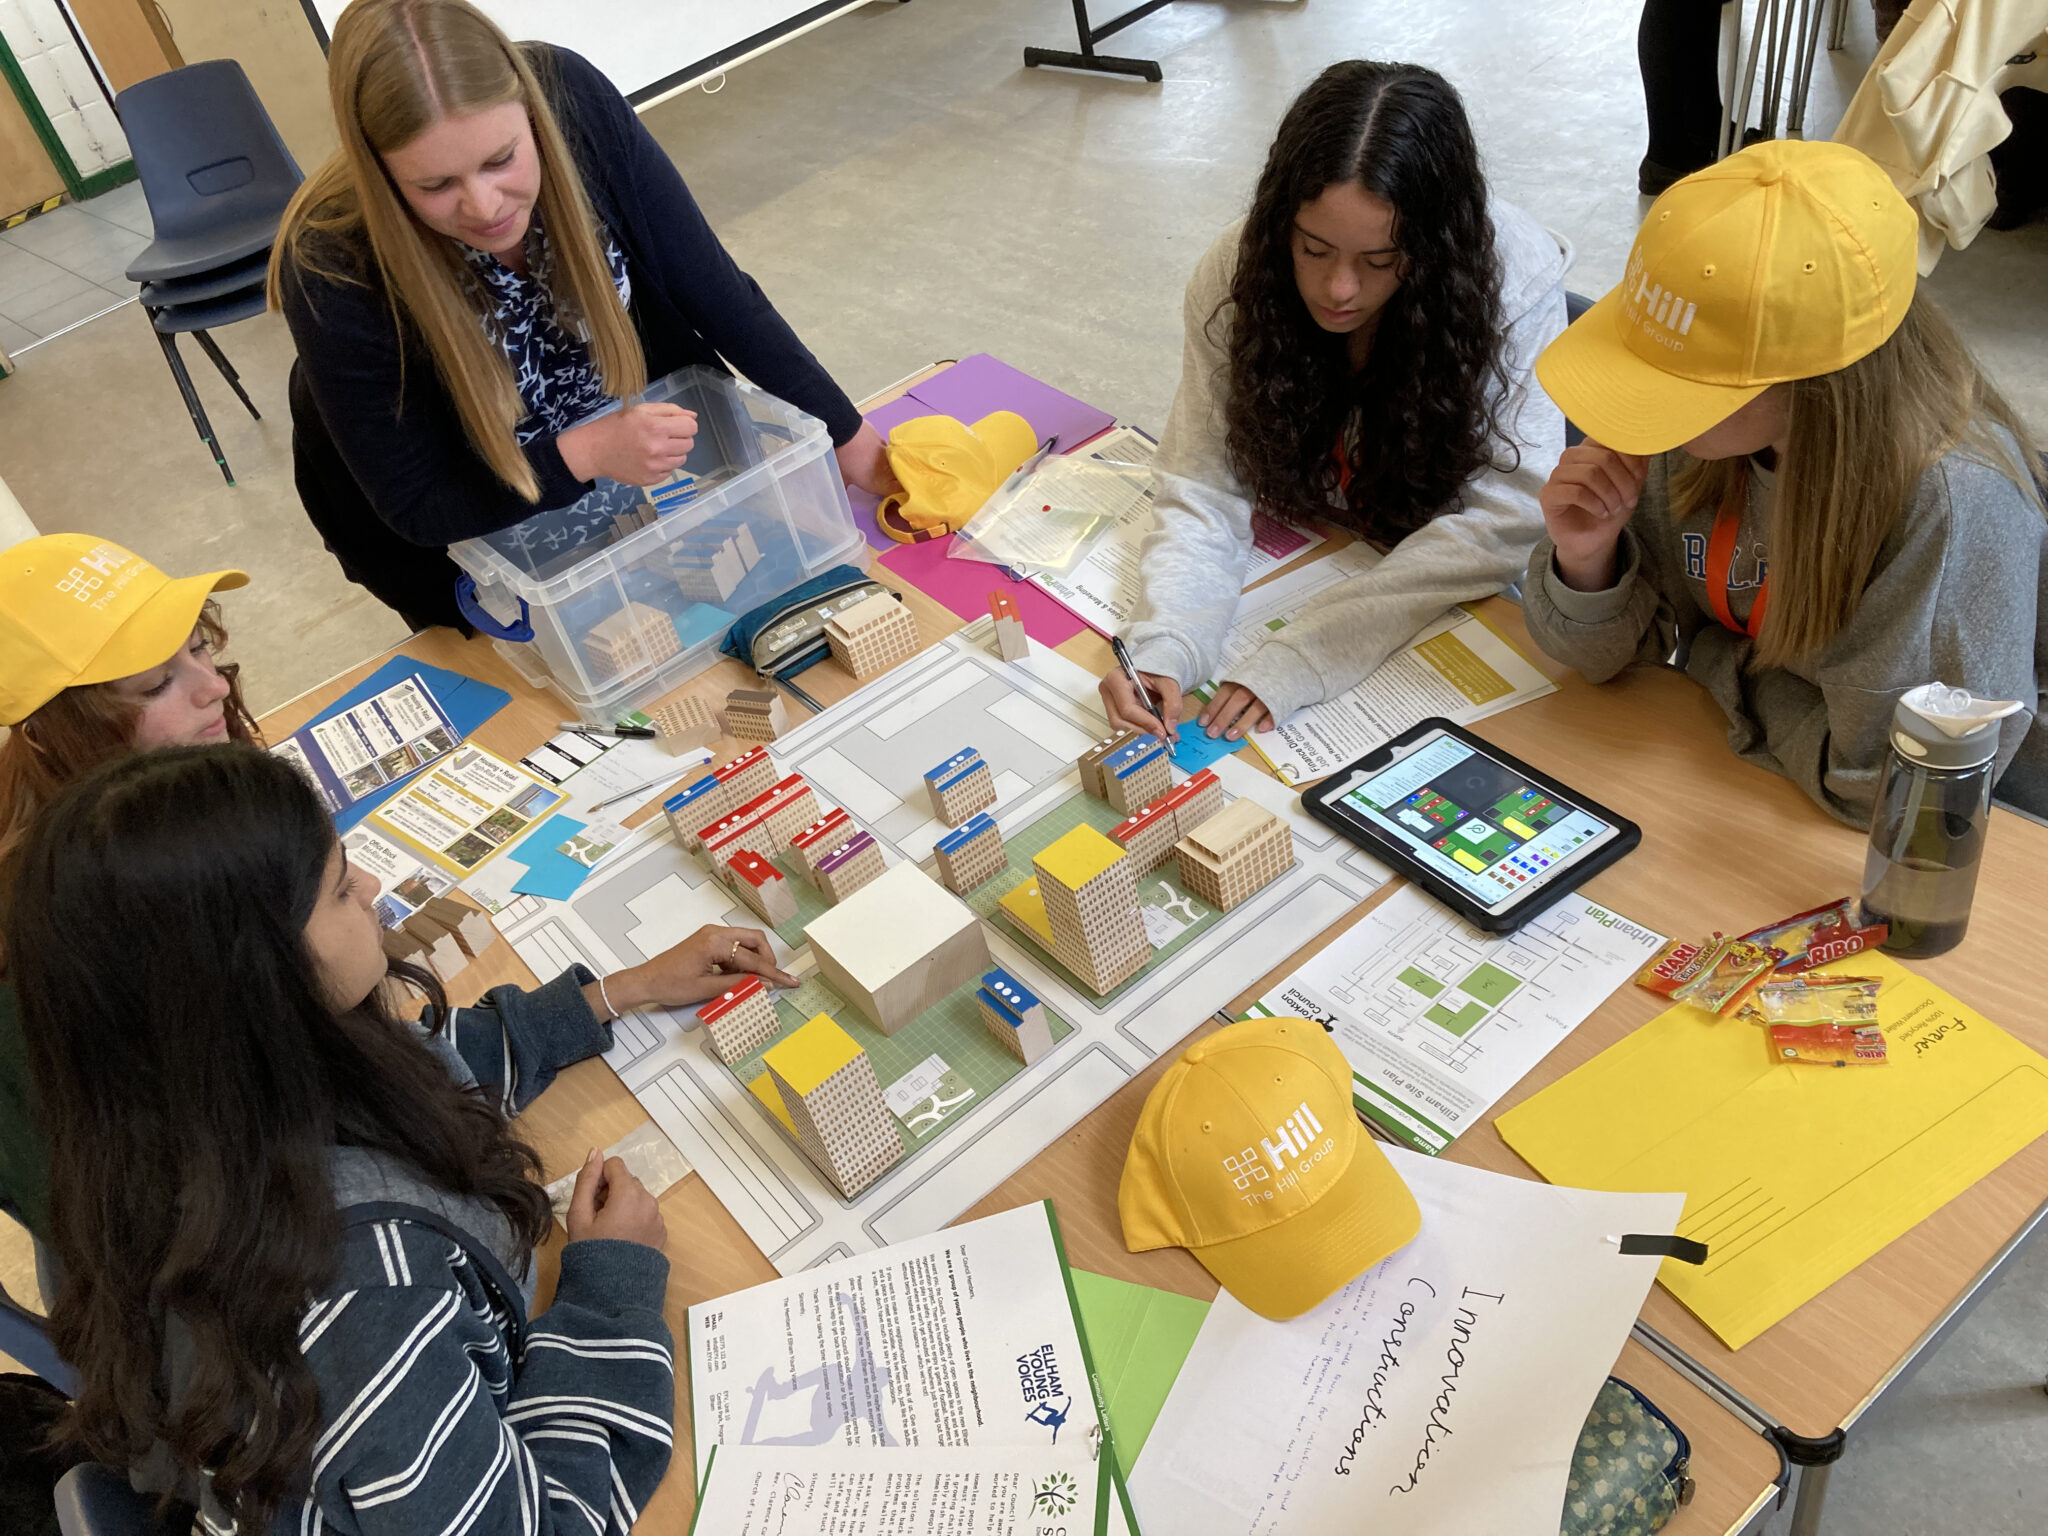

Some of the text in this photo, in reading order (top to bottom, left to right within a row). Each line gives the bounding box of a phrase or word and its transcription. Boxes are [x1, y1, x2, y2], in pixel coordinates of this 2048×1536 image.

[1634, 271, 1697, 336] Hill
[1642, 320, 1685, 353] Group
[1037, 570, 1075, 601] UrbanPlan
[1073, 582, 1104, 607] Marketing
[1100, 602, 1109, 611] &
[1105, 605, 1124, 622] Sales
[477, 754, 519, 782] Housing + Retail
[1273, 724, 1321, 775] Finance Directo
[1284, 721, 1330, 771] Job Role Guide
[367, 837, 398, 860] Office Block
[1582, 903, 1658, 949] UrbanPlan
[1278, 990, 1316, 1024] Yorkton
[1286, 983, 1323, 1018] Council
[1900, 996, 1934, 1023] Document
[1882, 1017, 1904, 1035] Wallet
[1897, 1007, 1944, 1044] 100% Recycled
[1380, 1065, 1461, 1123] Ellham Site Plan
[1260, 1101, 1325, 1171] Hill
[1410, 1132, 1439, 1157] Name
[1241, 1136, 1336, 1208] The Hill Group
[943, 1248, 952, 1259] We
[944, 1258, 954, 1269] are
[958, 1243, 976, 1299] Dear Council Members,
[947, 1273, 958, 1291] group
[951, 1290, 959, 1298] of
[952, 1297, 963, 1316] young
[955, 1315, 967, 1336] people
[959, 1335, 969, 1350] who
[962, 1349, 972, 1362] live
[964, 1361, 973, 1369] in
[966, 1368, 975, 1380] the
[1013, 1353, 1037, 1403] VOICES
[1026, 1349, 1050, 1400] YOUNG
[1038, 1342, 1064, 1398] ELLHAM
[1332, 1275, 1435, 1478] Constructions
[1388, 1283, 1505, 1496] Innovation
[968, 1379, 984, 1428] neighbourhood.
[1089, 1372, 1112, 1432] Community Letters
[744, 1470, 763, 1518] Church of St
[761, 1471, 781, 1523] Rev. Clarence
[817, 1472, 838, 1532] will stay stuck
[831, 1500, 842, 1513] and
[834, 1480, 845, 1497] safe
[837, 1472, 856, 1534] can provide the
[856, 1484, 873, 1534] ask that the
[878, 1472, 894, 1526] mental health
[887, 1472, 904, 1526] problems that
[895, 1472, 913, 1534] people get back
[906, 1473, 923, 1535] The solution is
[925, 1472, 943, 1535] homeless people
[937, 1472, 952, 1519] simply wish
[948, 1480, 960, 1510] growing
[964, 1472, 981, 1536] Homeless people
[985, 1472, 1000, 1531] worked to help
[997, 1472, 1010, 1515] As you are
[1007, 1472, 1020, 1522] Dear Council
